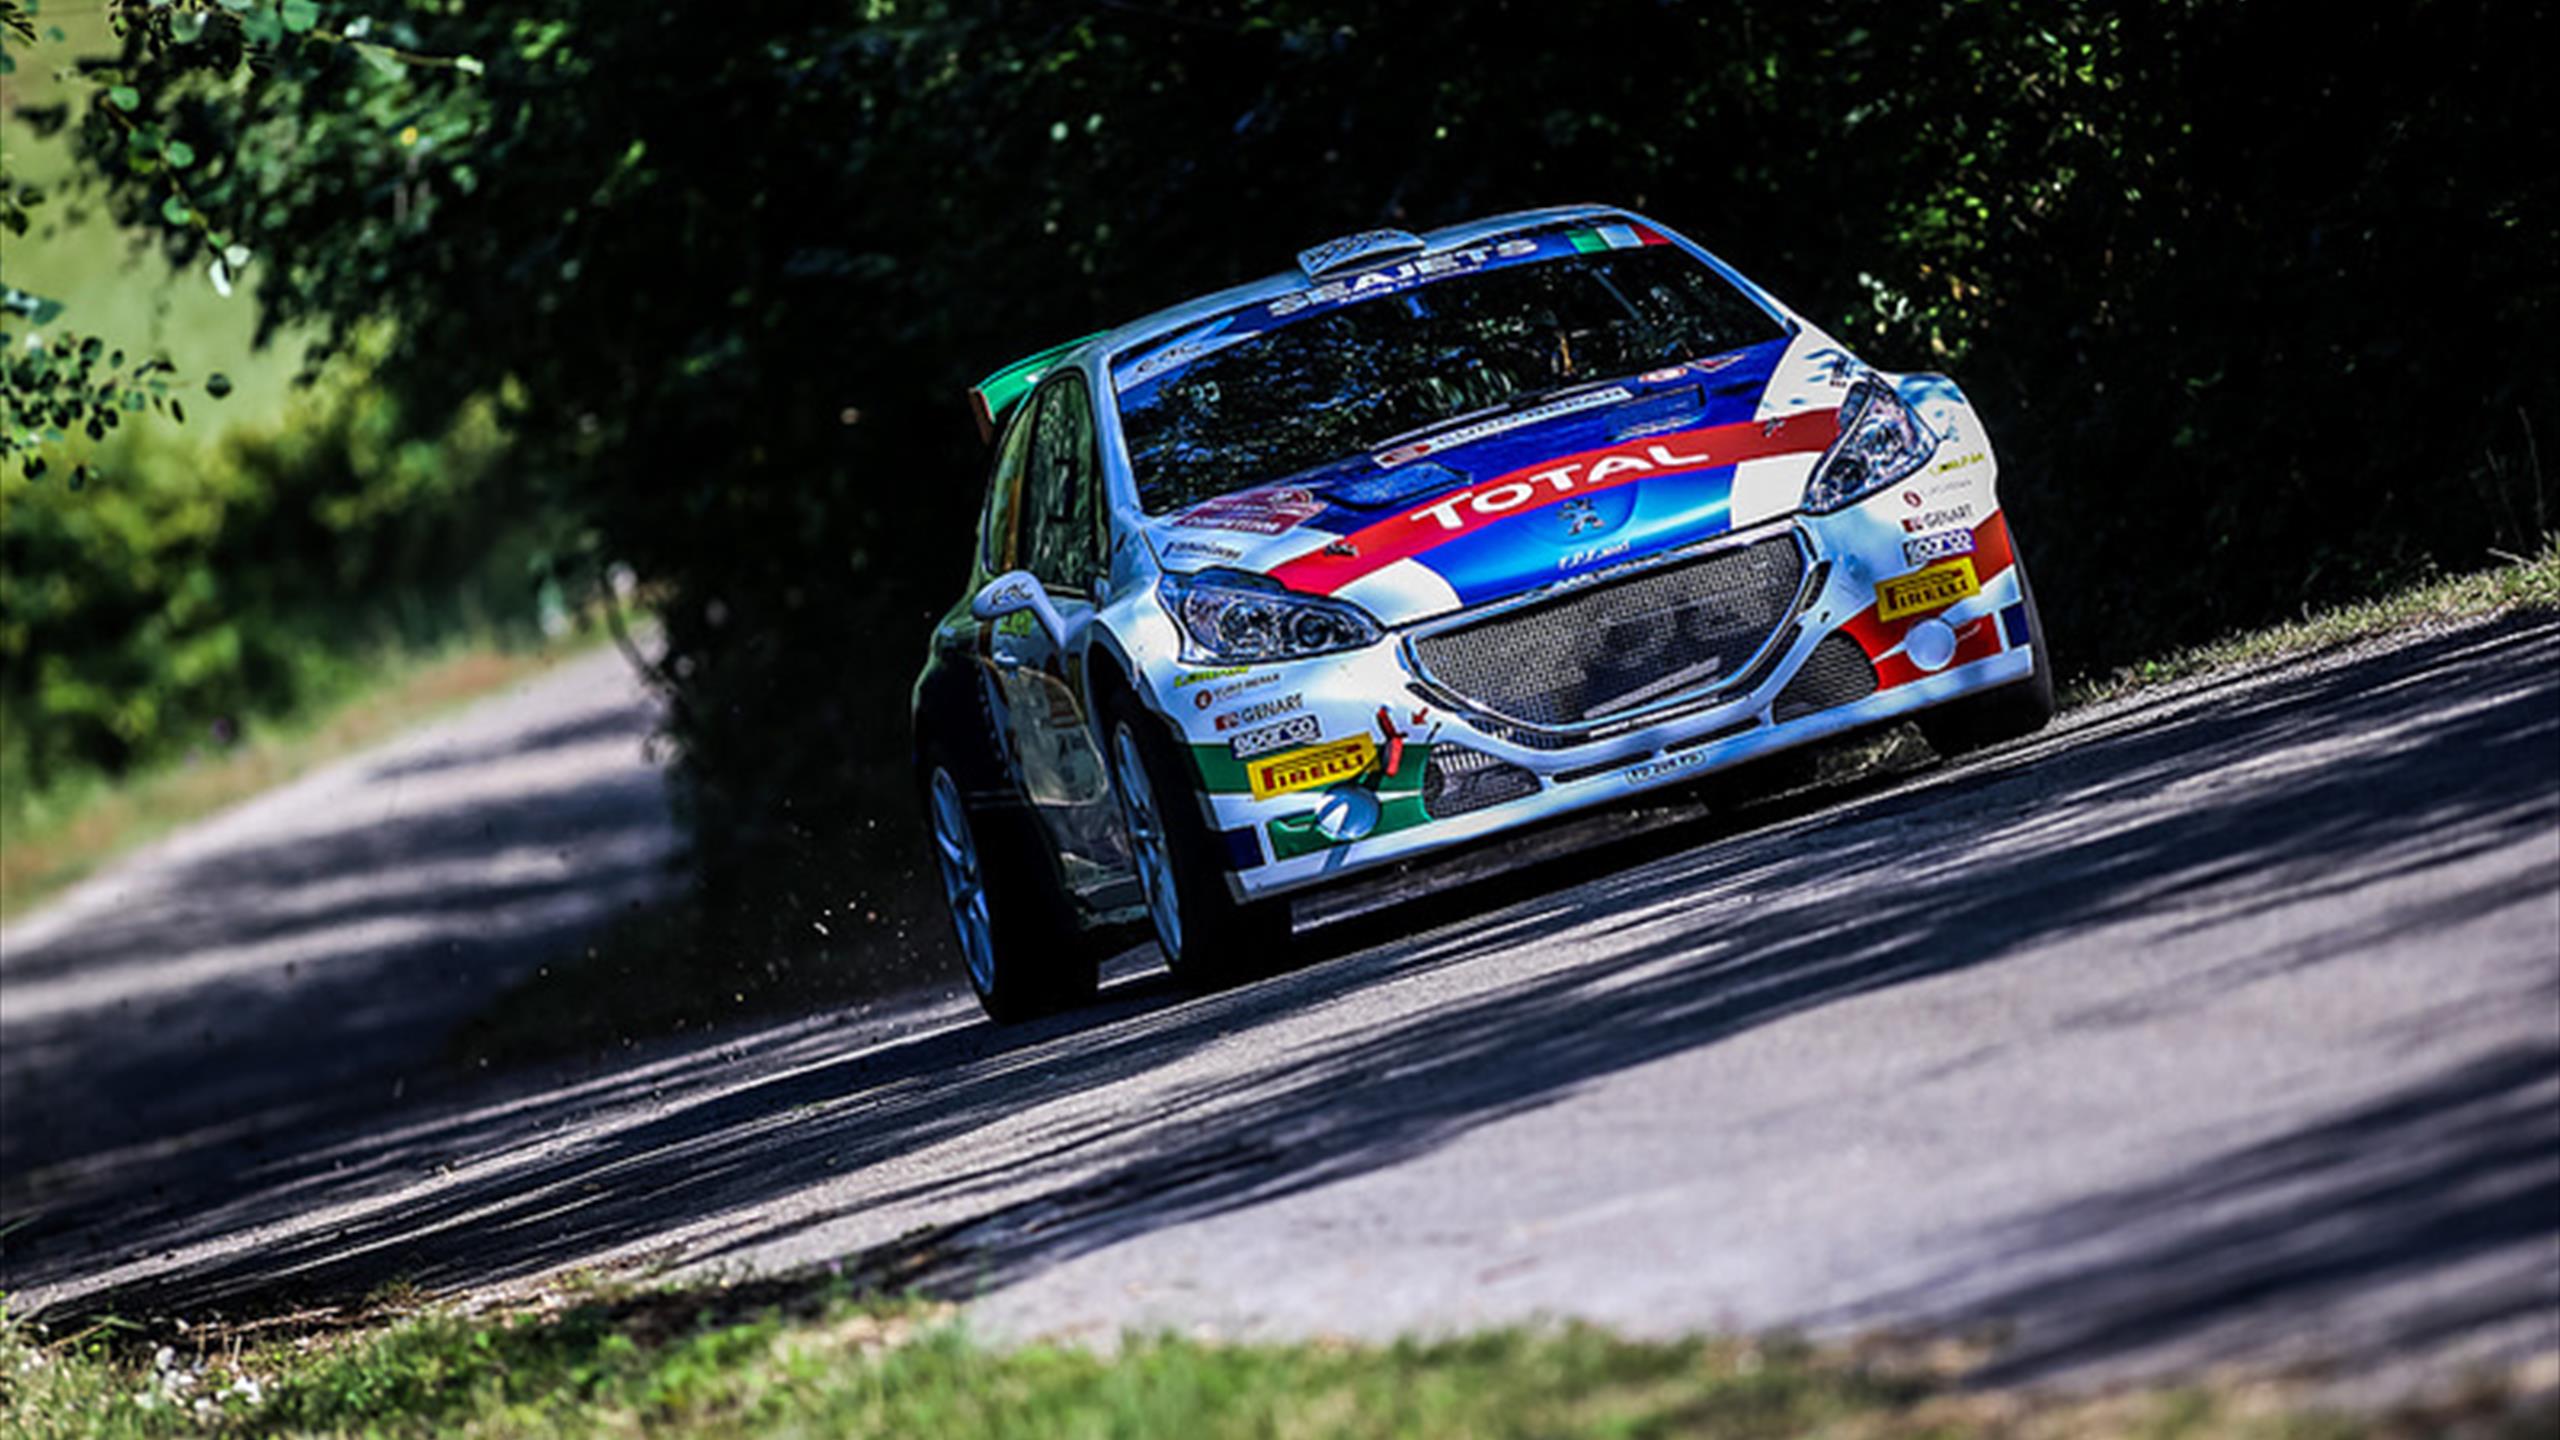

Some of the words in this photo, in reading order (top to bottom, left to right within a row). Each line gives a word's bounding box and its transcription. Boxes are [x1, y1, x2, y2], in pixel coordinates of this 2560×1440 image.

[1268, 239, 1537, 317] SEAJETS
[1410, 445, 1710, 530] TOTAL
[1884, 567, 1970, 611] PIRELLI
[1241, 693, 1304, 723] GENART
[1233, 716, 1316, 759] sparco
[1260, 743, 1365, 792] PIRELLI
